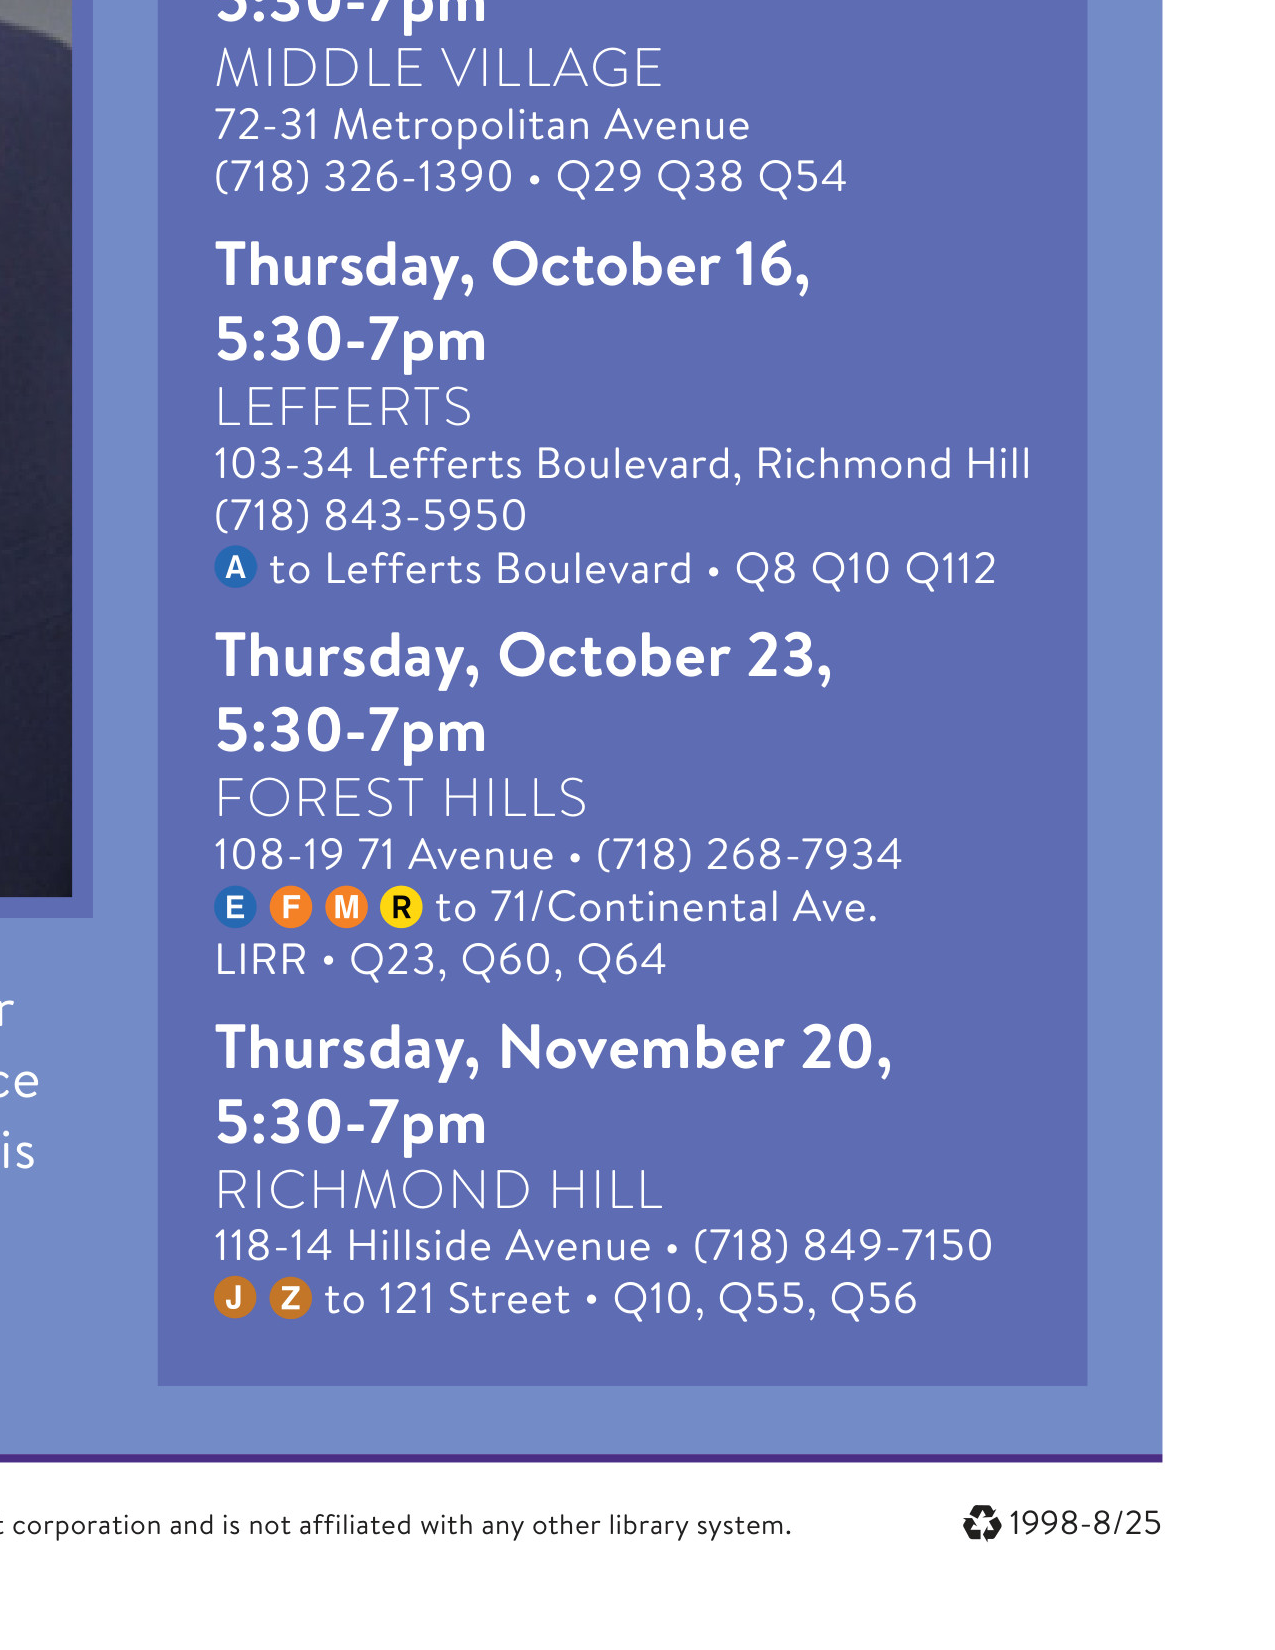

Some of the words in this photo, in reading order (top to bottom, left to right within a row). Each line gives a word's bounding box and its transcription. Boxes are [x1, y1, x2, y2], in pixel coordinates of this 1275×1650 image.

[217, 48, 422, 87] MIDDLE
[441, 47, 661, 87] VILLAGE
[215, 108, 315, 140] 72-31
[334, 108, 588, 150] Metropolitan
[604, 108, 749, 140] Avenue
[216, 160, 308, 194] (718)
[325, 160, 511, 192] 326-1390
[558, 160, 641, 200] Q29
[658, 160, 742, 200] Q38
[760, 160, 846, 200] Q54
[215, 241, 473, 300] Thursday,
[493, 241, 721, 286] October
[736, 240, 808, 297] 16,
[218, 315, 484, 375] 5:30-7pm
[219, 386, 470, 426] LEFFERTS
[216, 447, 352, 479] 103-34
[370, 447, 521, 479] Lefferts
[539, 447, 740, 485] Boulevard,
[759, 447, 950, 479] Richmond
[969, 447, 1028, 478] Hill
[216, 499, 308, 534] (718)
[326, 499, 525, 531] 843-5950
[328, 552, 481, 584] Lefferts
[499, 552, 690, 584] Boulevard
[737, 552, 795, 592] Q8
[813, 552, 889, 592] Q10
[907, 552, 994, 592] Q112
[215, 632, 478, 691] Thursday,
[500, 632, 731, 677] October
[749, 632, 830, 688] 23,
[218, 706, 484, 766] 5:30-7pm
[219, 777, 423, 817] FOREST
[446, 777, 585, 817] HILLS
[216, 838, 342, 870] 108-19
[359, 838, 391, 869] 71
[408, 838, 553, 870] Avenue
[598, 838, 691, 872] (718)
[708, 838, 901, 870] 268-7934
[491, 890, 777, 922] 71/Continental
[793, 890, 876, 922] Ave.
[218, 943, 305, 974] LIRR
[351, 943, 445, 983] Q23,
[463, 943, 561, 983] Q60,
[579, 943, 665, 983] Q64
[215, 1024, 478, 1083] Thursday,
[502, 1024, 785, 1069] November
[802, 1024, 890, 1080] 20,
[218, 1098, 484, 1158] 5:30-7pm
[219, 1169, 529, 1209] RICHMOND
[553, 1170, 662, 1208] HILL
[216, 1229, 332, 1261] 118-14
[350, 1229, 490, 1261] Hillside
[505, 1229, 650, 1261] Avenue
[695, 1229, 787, 1264] (718)
[805, 1229, 991, 1261] 849-7150
[381, 1282, 430, 1313] 121
[450, 1282, 570, 1314] Street
[615, 1282, 703, 1322] Q10,
[720, 1282, 815, 1322] Q55,
[832, 1282, 916, 1322] Q56
[13, 1514, 160, 1541] corporation
[170, 1514, 212, 1535] and
[224, 1514, 239, 1535] is
[250, 1517, 291, 1535] not
[300, 1514, 410, 1535] affiliated
[421, 1514, 472, 1534] with
[482, 1521, 524, 1541] any
[533, 1514, 600, 1535] other
[611, 1514, 689, 1541] library
[698, 1517, 790, 1541] system.
[1011, 1510, 1160, 1535] 1998-8/25
